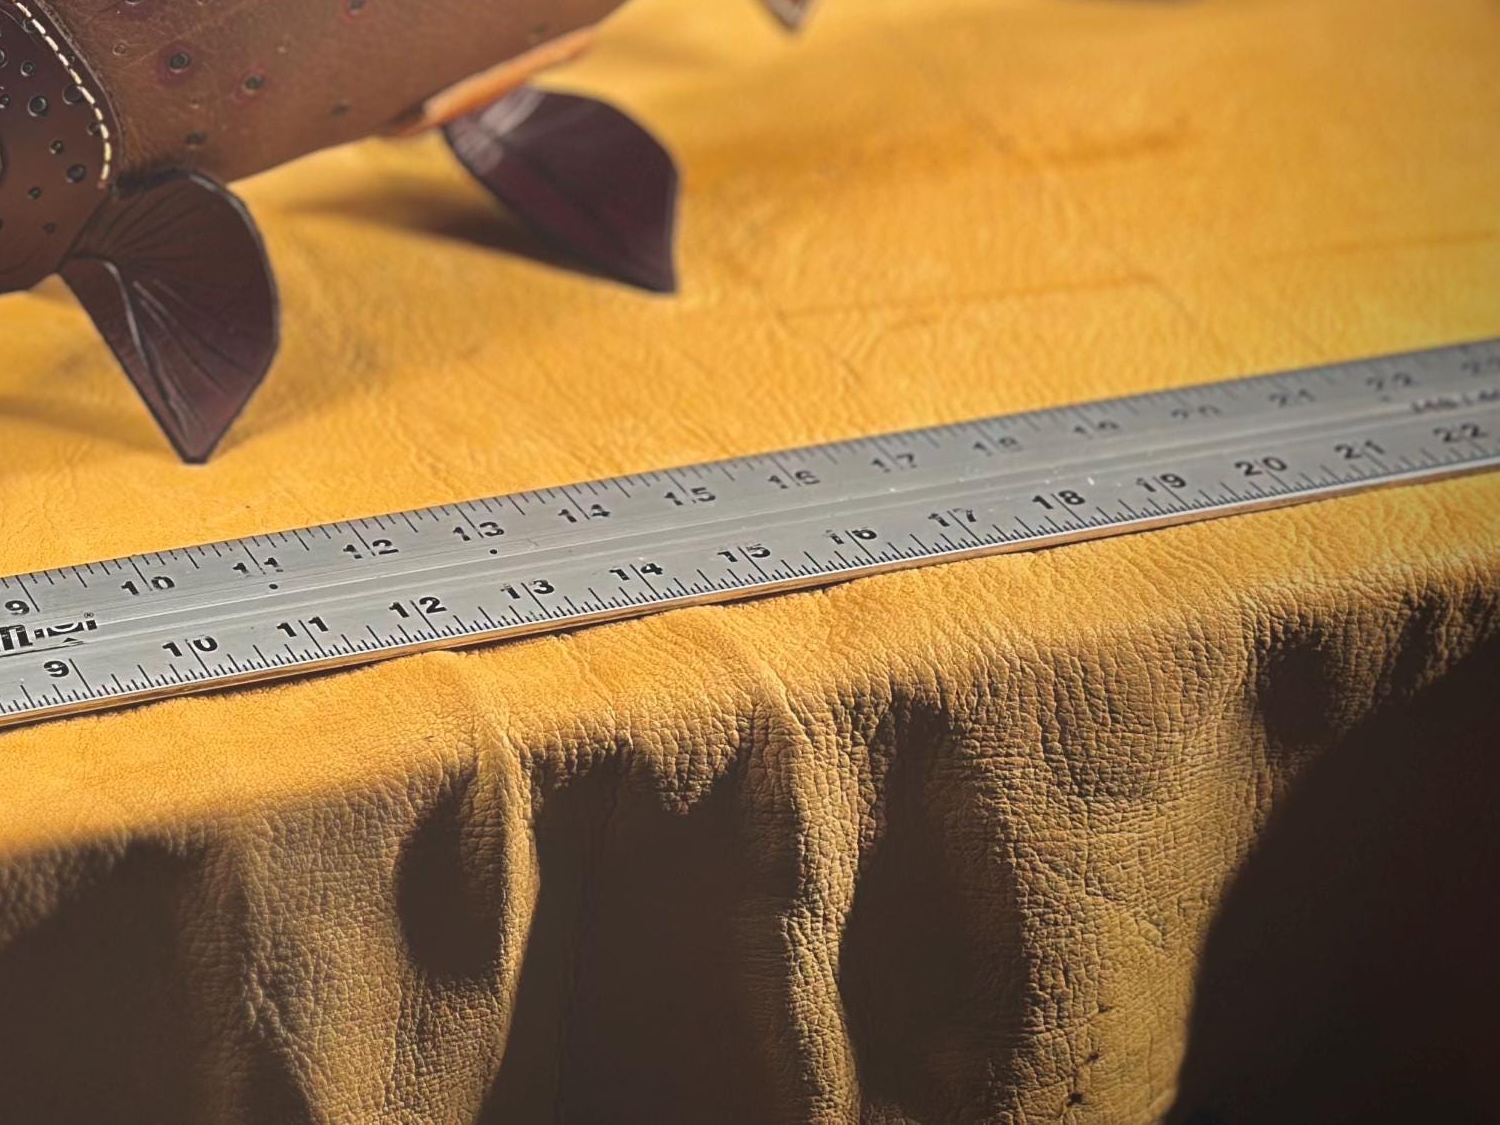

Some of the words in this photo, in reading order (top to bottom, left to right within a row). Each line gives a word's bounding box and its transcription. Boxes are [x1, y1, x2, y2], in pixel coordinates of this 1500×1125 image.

[4, 600, 30, 616] 9
[121, 575, 176, 596] 10
[232, 557, 284, 575] 11
[343, 539, 399, 559] 12
[453, 521, 505, 541] 13
[558, 504, 612, 523] 14
[664, 487, 717, 507] 15
[871, 453, 918, 473] 17
[43, 660, 70, 677] 9
[162, 636, 218, 658] 10
[276, 616, 329, 637] 11
[389, 596, 447, 619] 12
[500, 579, 555, 600] 13
[609, 562, 664, 581] 14
[717, 543, 771, 563] 15
[825, 527, 878, 545] 16
[928, 508, 977, 528] 17
[1031, 490, 1085, 511] 18
[1136, 472, 1187, 493] 19
[1234, 456, 1288, 477] 20
[1334, 440, 1385, 460] 21
[1433, 423, 1489, 444] 22
